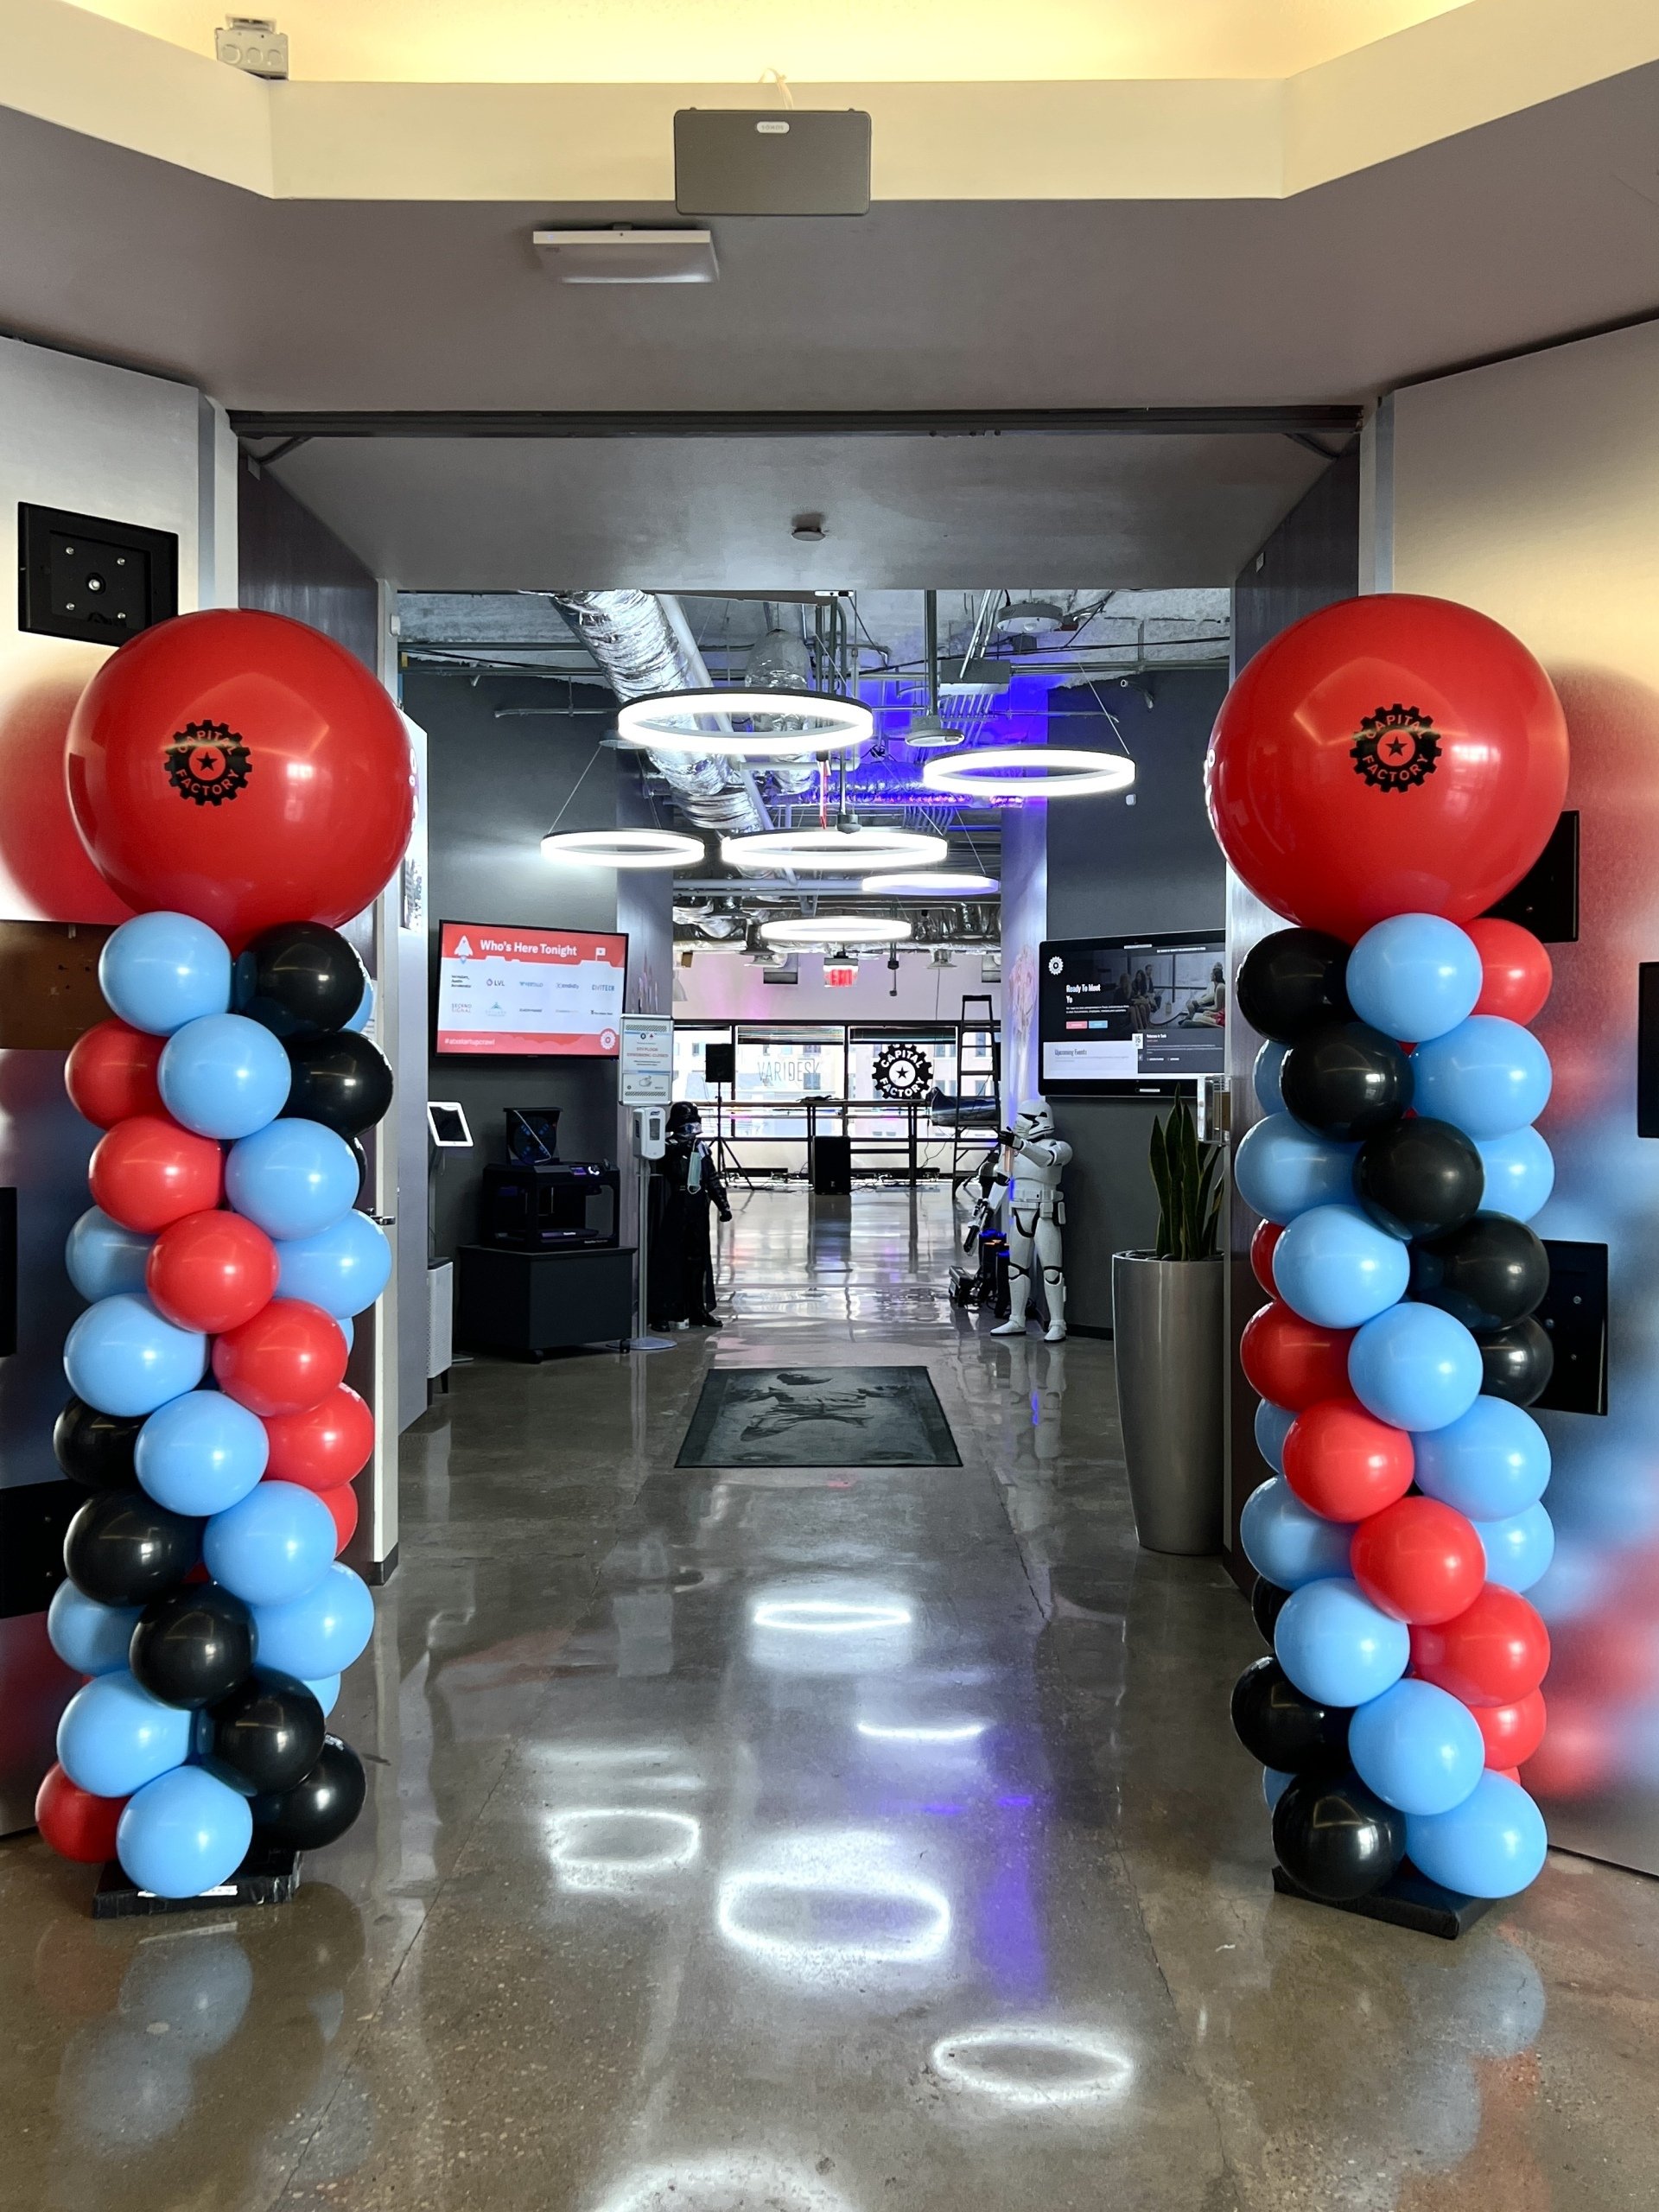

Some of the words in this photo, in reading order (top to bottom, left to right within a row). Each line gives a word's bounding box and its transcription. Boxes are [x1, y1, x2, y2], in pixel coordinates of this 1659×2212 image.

[1366, 714, 1427, 740] CAPITAL
[176, 729, 237, 755] CAPITAL
[1362, 753, 1427, 782] FACTORY
[175, 768, 239, 796] FACTORY
[480, 939, 512, 952] Who's
[514, 942, 539, 954] Here
[540, 944, 577, 958] Tonight
[880, 1049, 924, 1068] CAPITAL
[757, 1061, 820, 1082] VARIDESK
[880, 1077, 925, 1097] FACTORY
